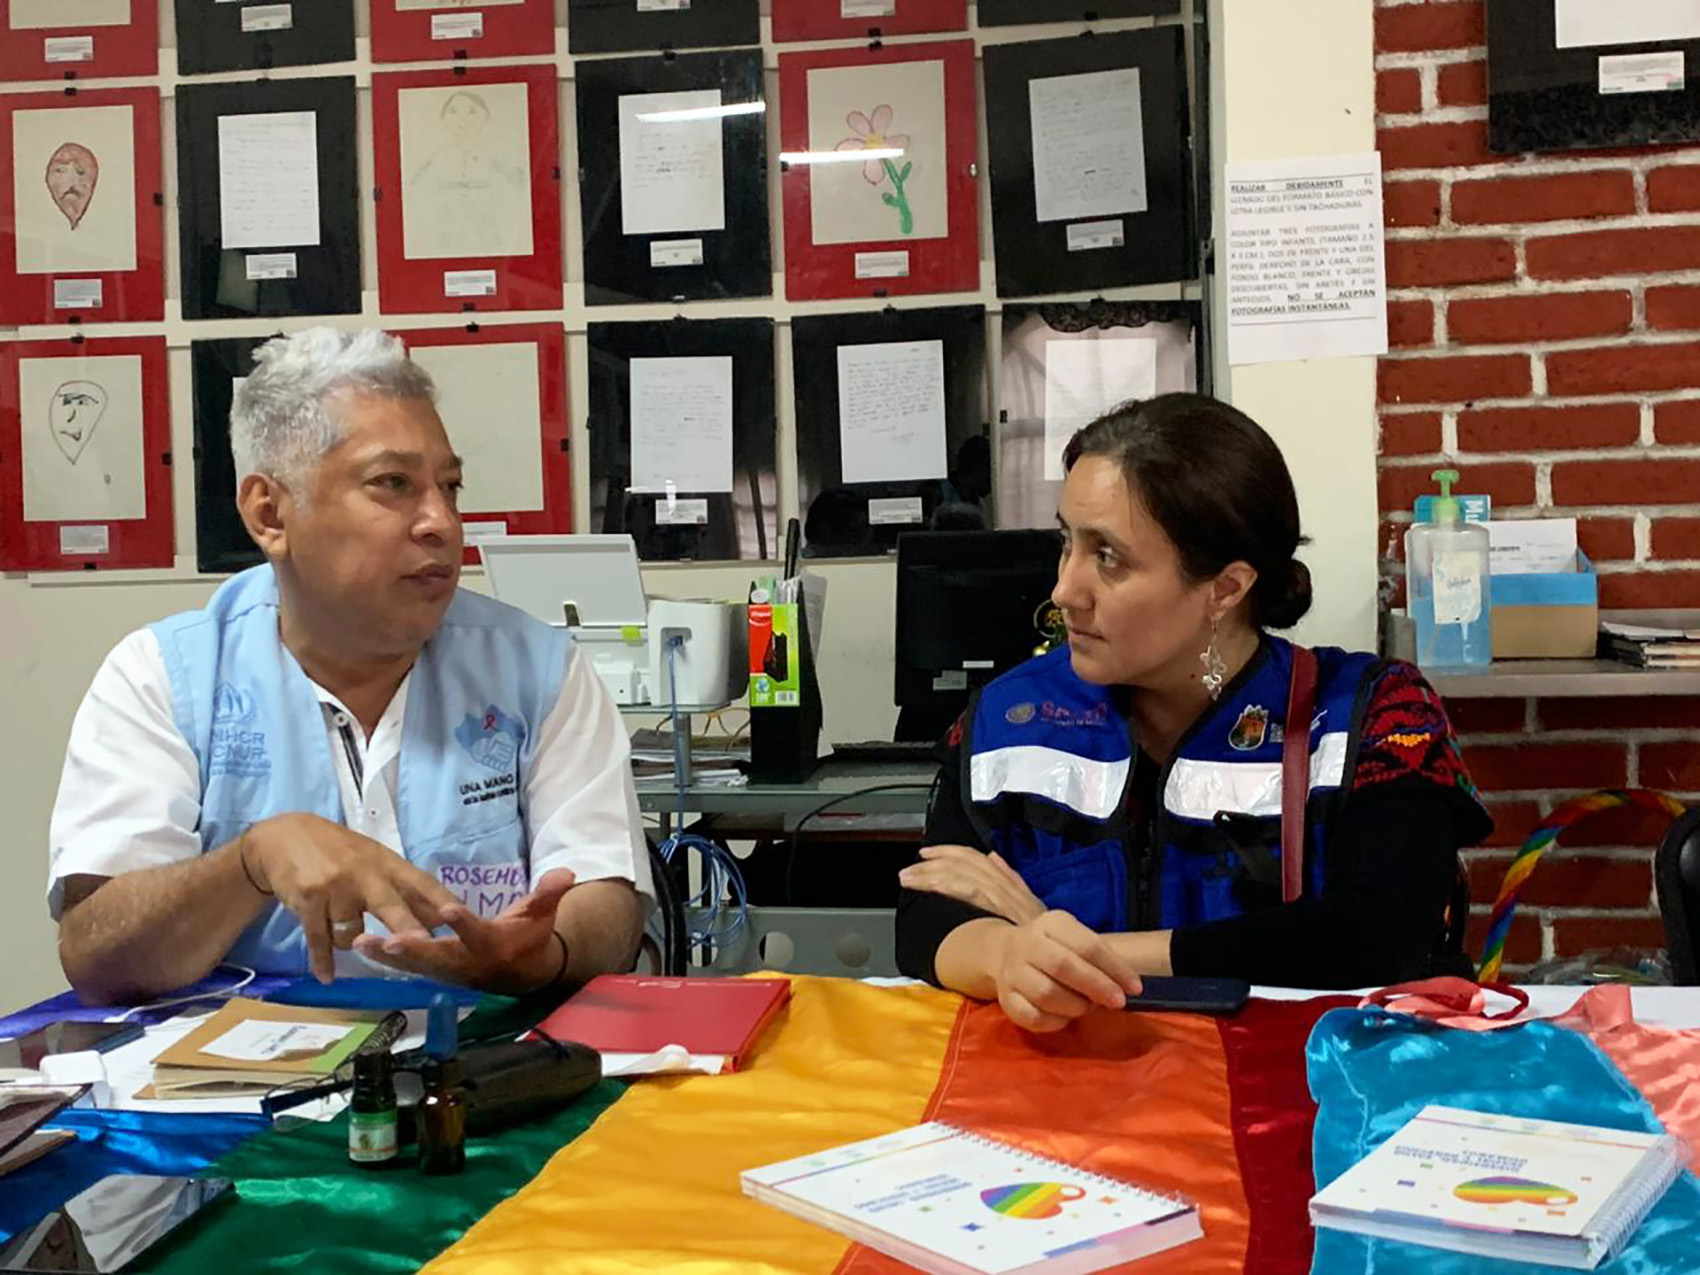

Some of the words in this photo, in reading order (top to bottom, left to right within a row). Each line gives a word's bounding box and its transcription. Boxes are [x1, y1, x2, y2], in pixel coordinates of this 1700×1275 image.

[1231, 184, 1266, 193] REALIZAR
[1286, 180, 1343, 190] DEBIDAMENTE
[1267, 194, 1280, 202] DEL
[1283, 191, 1323, 201] FORMATO
[1355, 188, 1374, 197] CON
[1288, 293, 1300, 302] NO
[1315, 292, 1323, 300] SE
[1339, 288, 1375, 299] ACEPTAN
[460, 783, 481, 795] UNA
